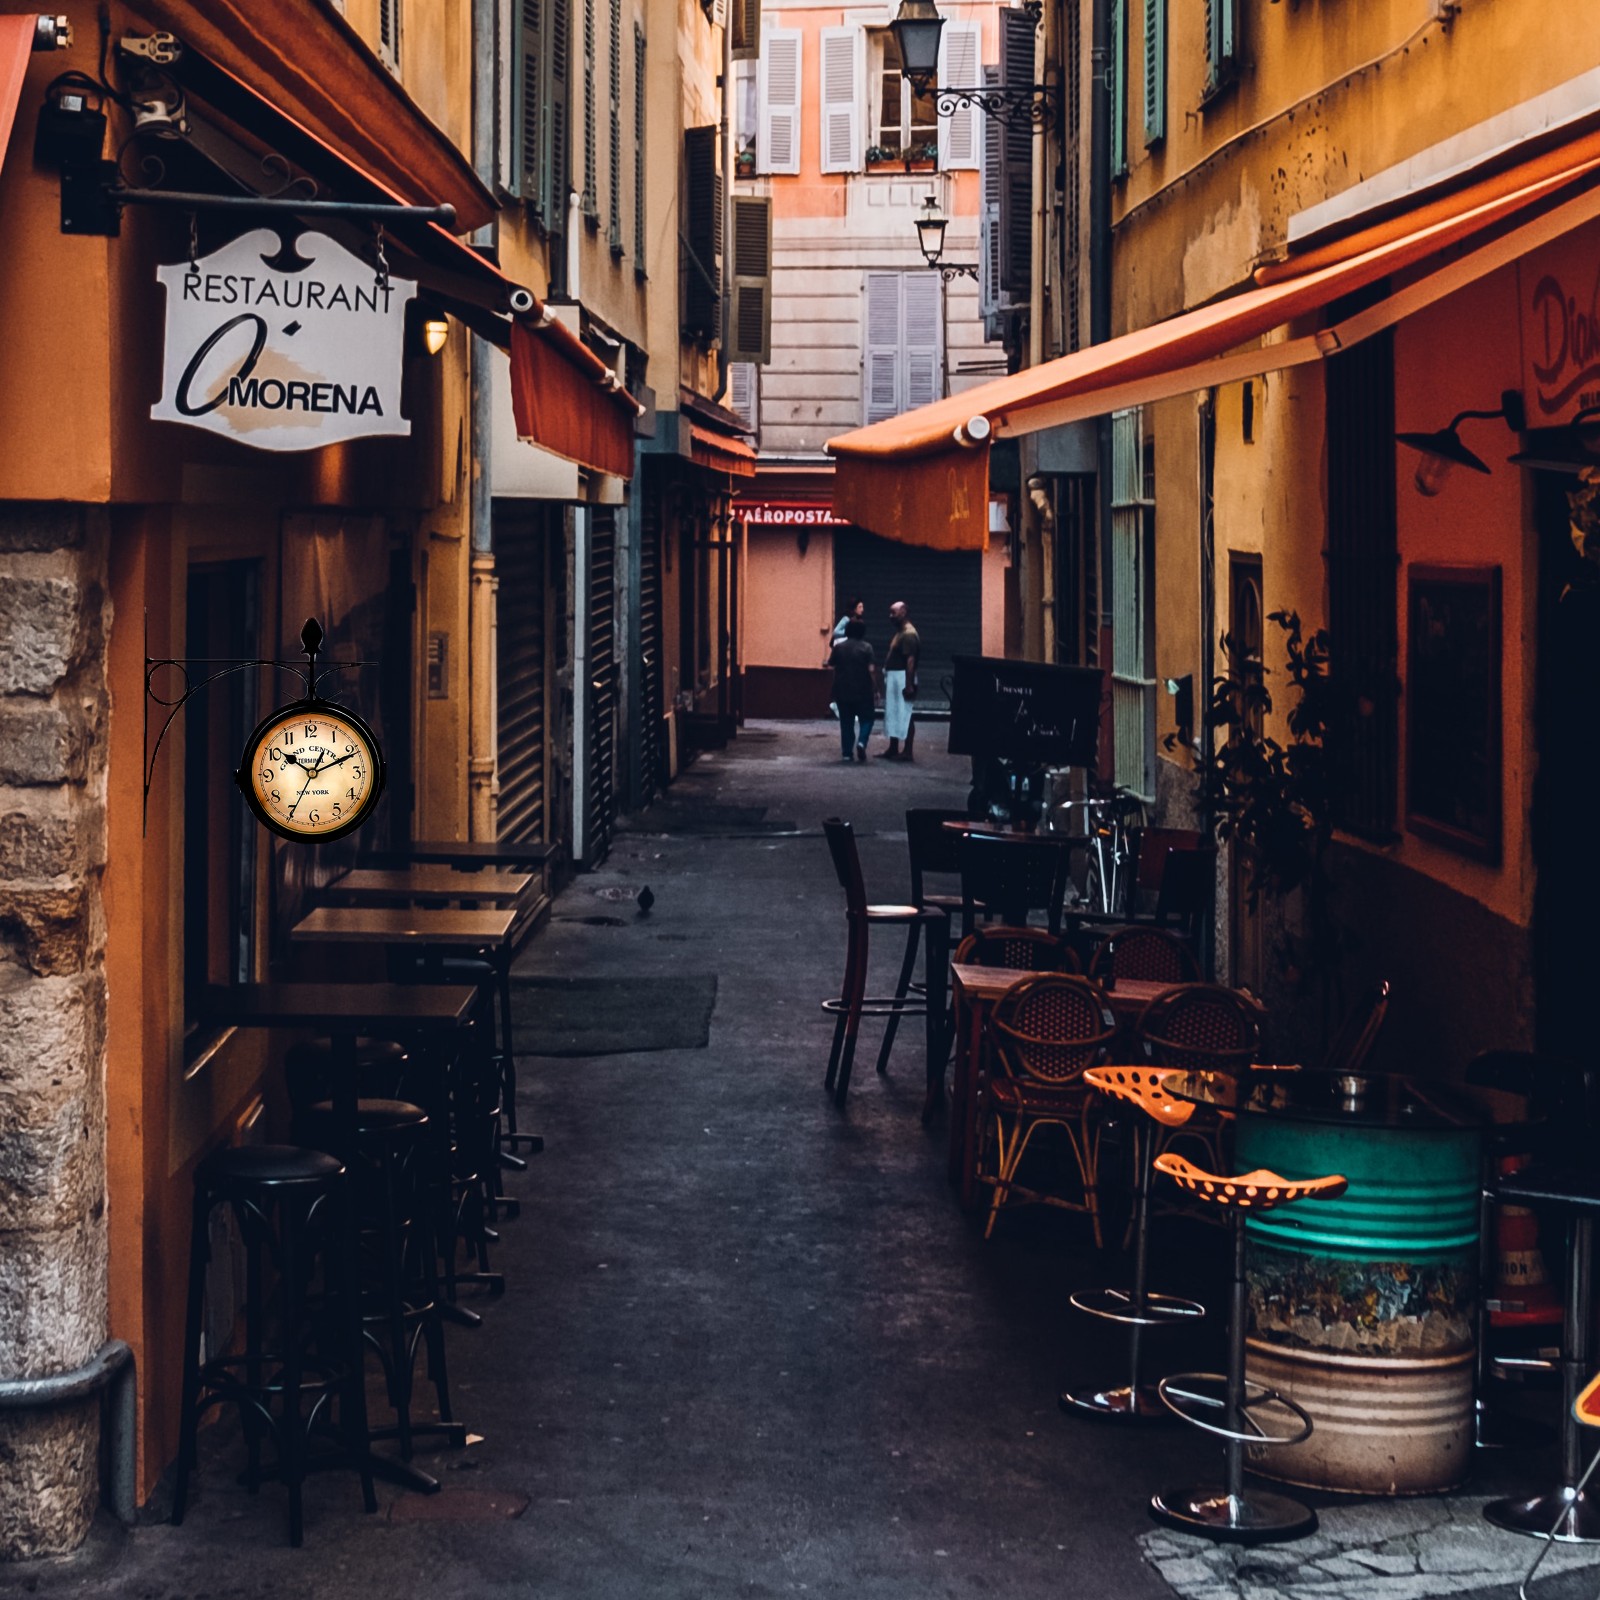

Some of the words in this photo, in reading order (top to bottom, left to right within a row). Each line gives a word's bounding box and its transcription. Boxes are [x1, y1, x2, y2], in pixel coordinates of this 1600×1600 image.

[183, 272, 395, 314] RESTAURANT
[285, 732, 294, 745] 11
[304, 724, 318, 738] 12
[331, 730, 336, 744] 1
[269, 747, 282, 762] 10
[345, 744, 355, 758] 2
[280, 747, 305, 771] GND
[262, 768, 274, 783] 9
[352, 765, 362, 780] 3
[270, 789, 281, 804] 8
[345, 788, 356, 800] 4
[287, 804, 297, 819] 7
[309, 808, 320, 823] 6
[332, 803, 341, 816] 5
